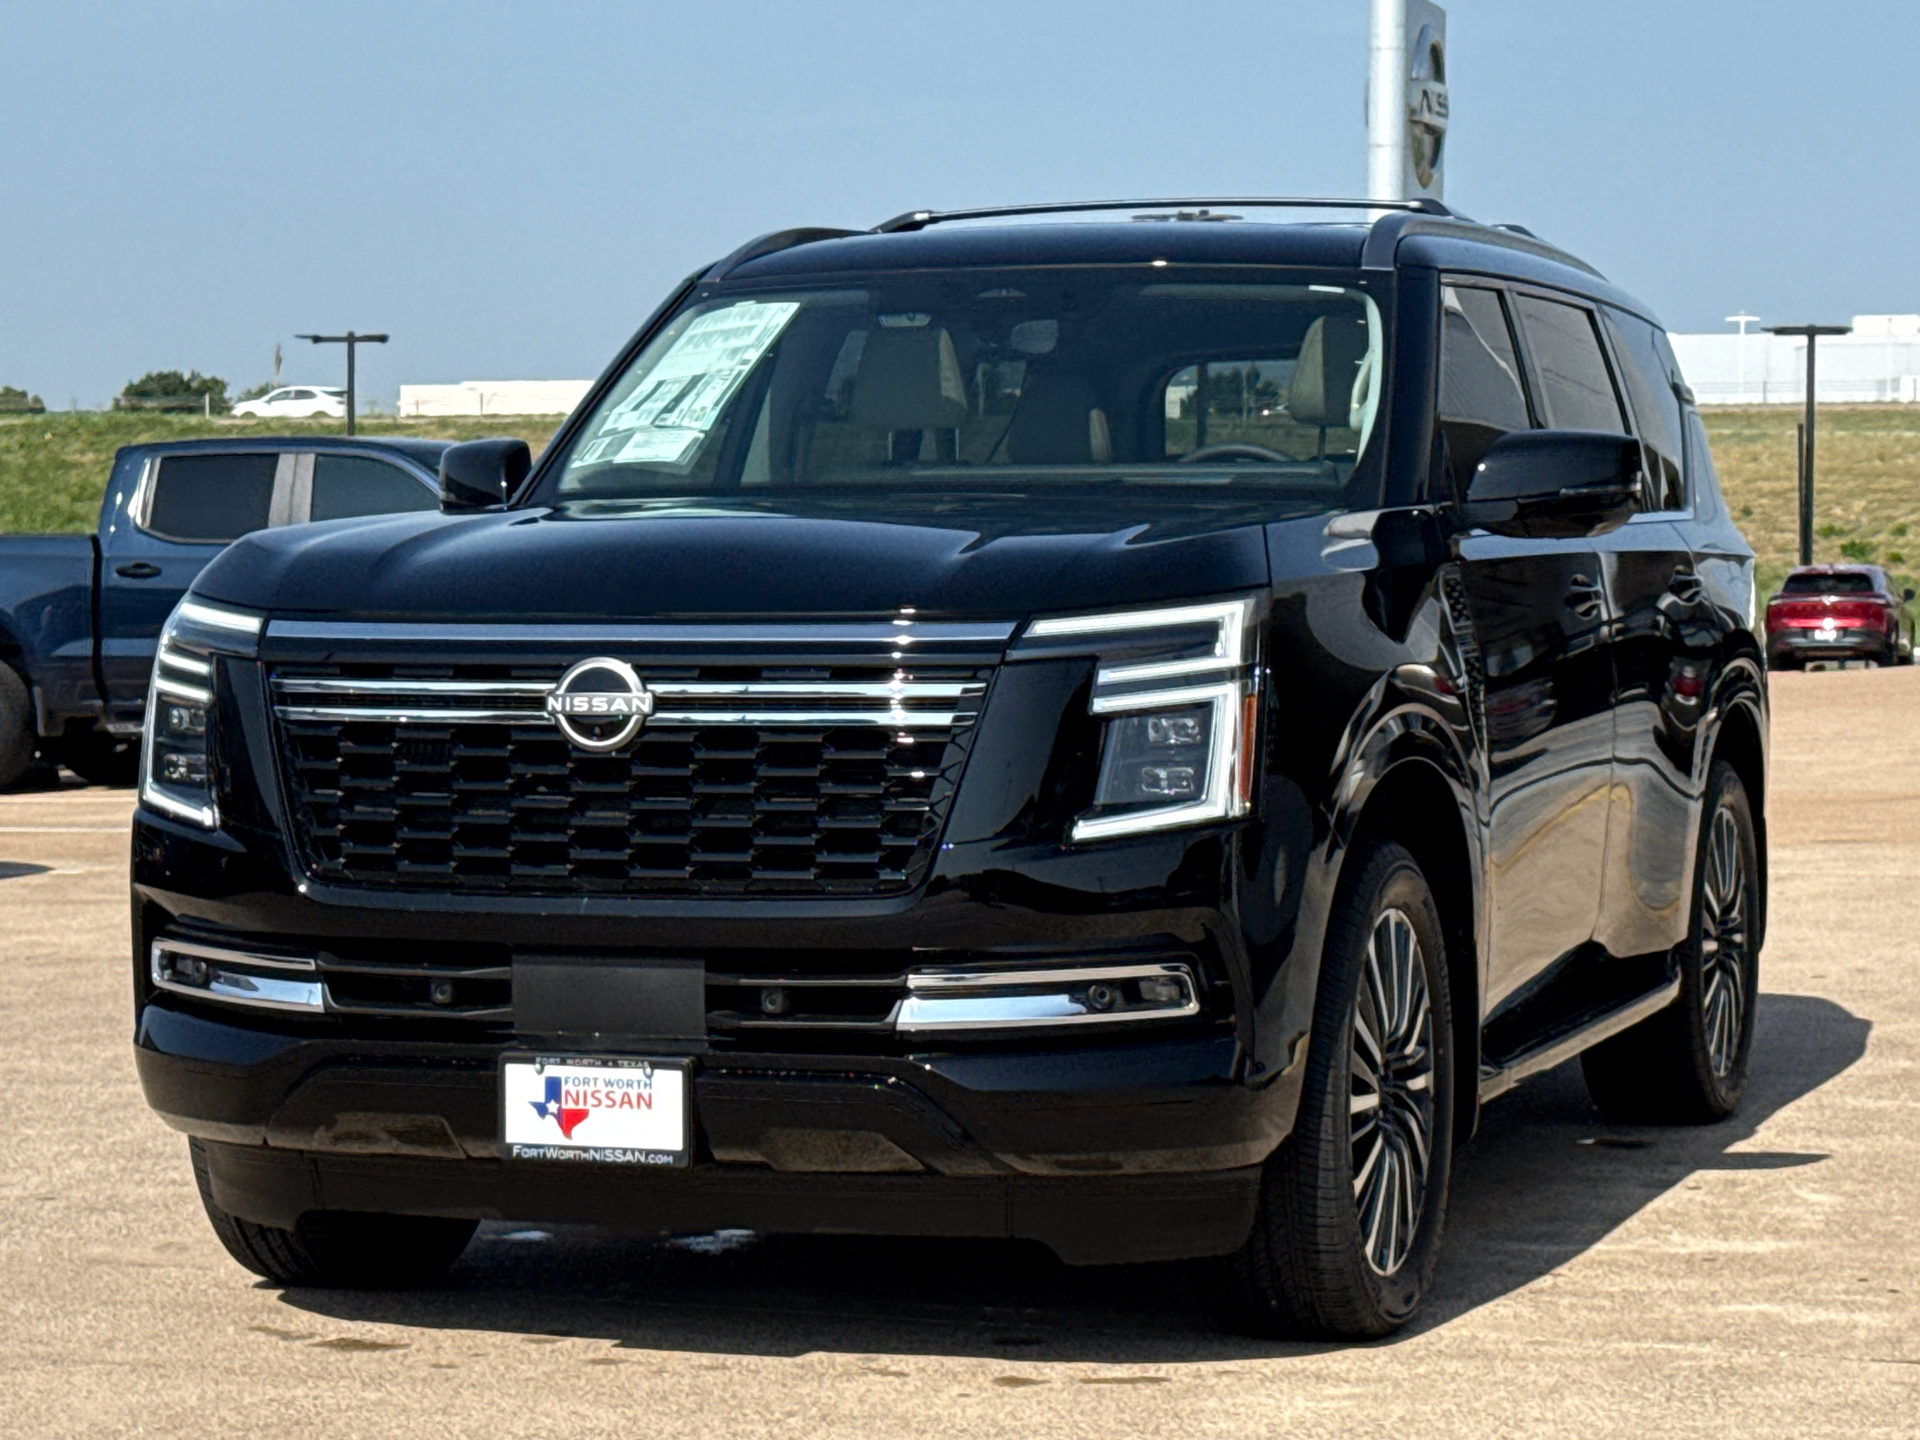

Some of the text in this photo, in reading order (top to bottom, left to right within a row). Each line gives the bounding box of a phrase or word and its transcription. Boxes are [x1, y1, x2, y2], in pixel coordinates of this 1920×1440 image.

[547, 696, 650, 713] NISSAN
[564, 1076, 653, 1090] FORT WORTH
[564, 1089, 653, 1110] NISSAN
